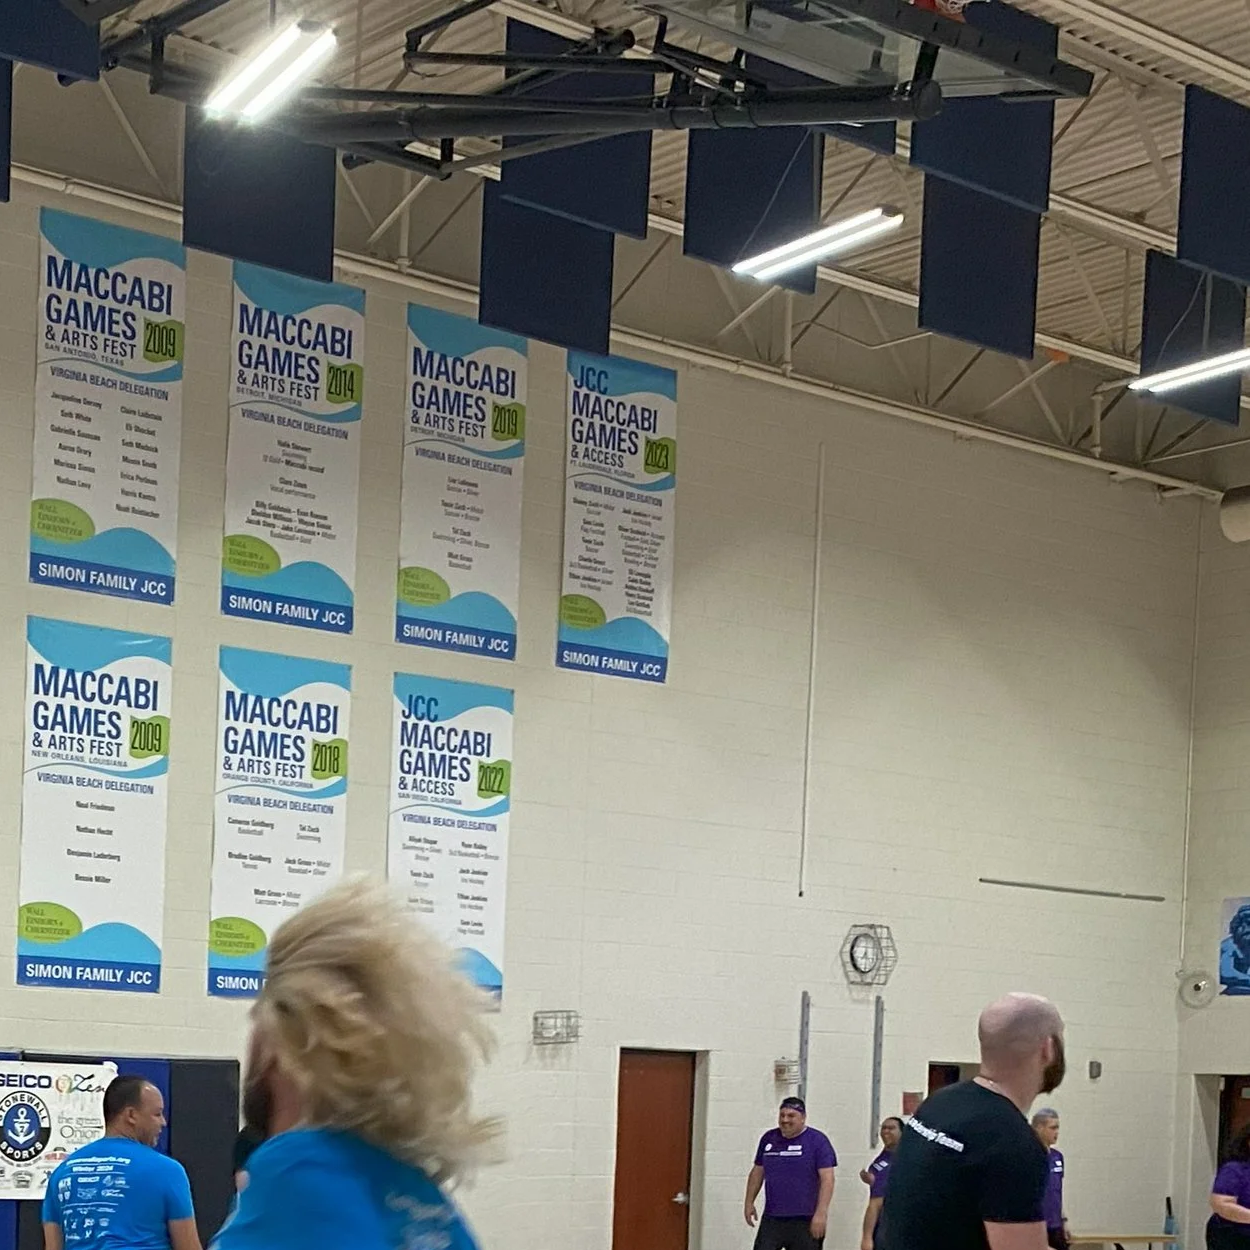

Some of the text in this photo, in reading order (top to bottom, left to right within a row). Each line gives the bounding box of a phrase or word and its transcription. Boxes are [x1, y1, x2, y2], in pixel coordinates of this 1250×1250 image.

[47, 255, 172, 315] MACCABI
[46, 293, 136, 341] GAMES
[239, 303, 352, 359] MACCABI
[146, 323, 175, 357] 2009
[238, 340, 320, 384] GAMES
[413, 346, 515, 398] MACCABI
[574, 365, 608, 394] JCC
[328, 366, 354, 399] 2014
[412, 382, 486, 422] GAMES
[572, 391, 657, 433] MACCABI
[493, 405, 517, 436] 2019
[572, 418, 639, 455] GAMES
[34, 663, 158, 711] MACCABI
[33, 701, 122, 739] GAMES
[225, 690, 338, 735] MACCABI
[402, 694, 438, 723] JCC
[132, 720, 161, 752] 2009
[224, 726, 305, 762] GAMES
[401, 721, 491, 757] MACCABI
[32, 750, 48, 758] NEW
[89, 758, 128, 767] LOUISIANA
[313, 743, 339, 774] 2018
[400, 749, 471, 782] GAMES
[479, 765, 504, 793] 2022
[26, 964, 152, 985] SIMON FAMILY JCC
[217, 976, 258, 991] SIMON
[0, 1141, 43, 1159] SPORTS
